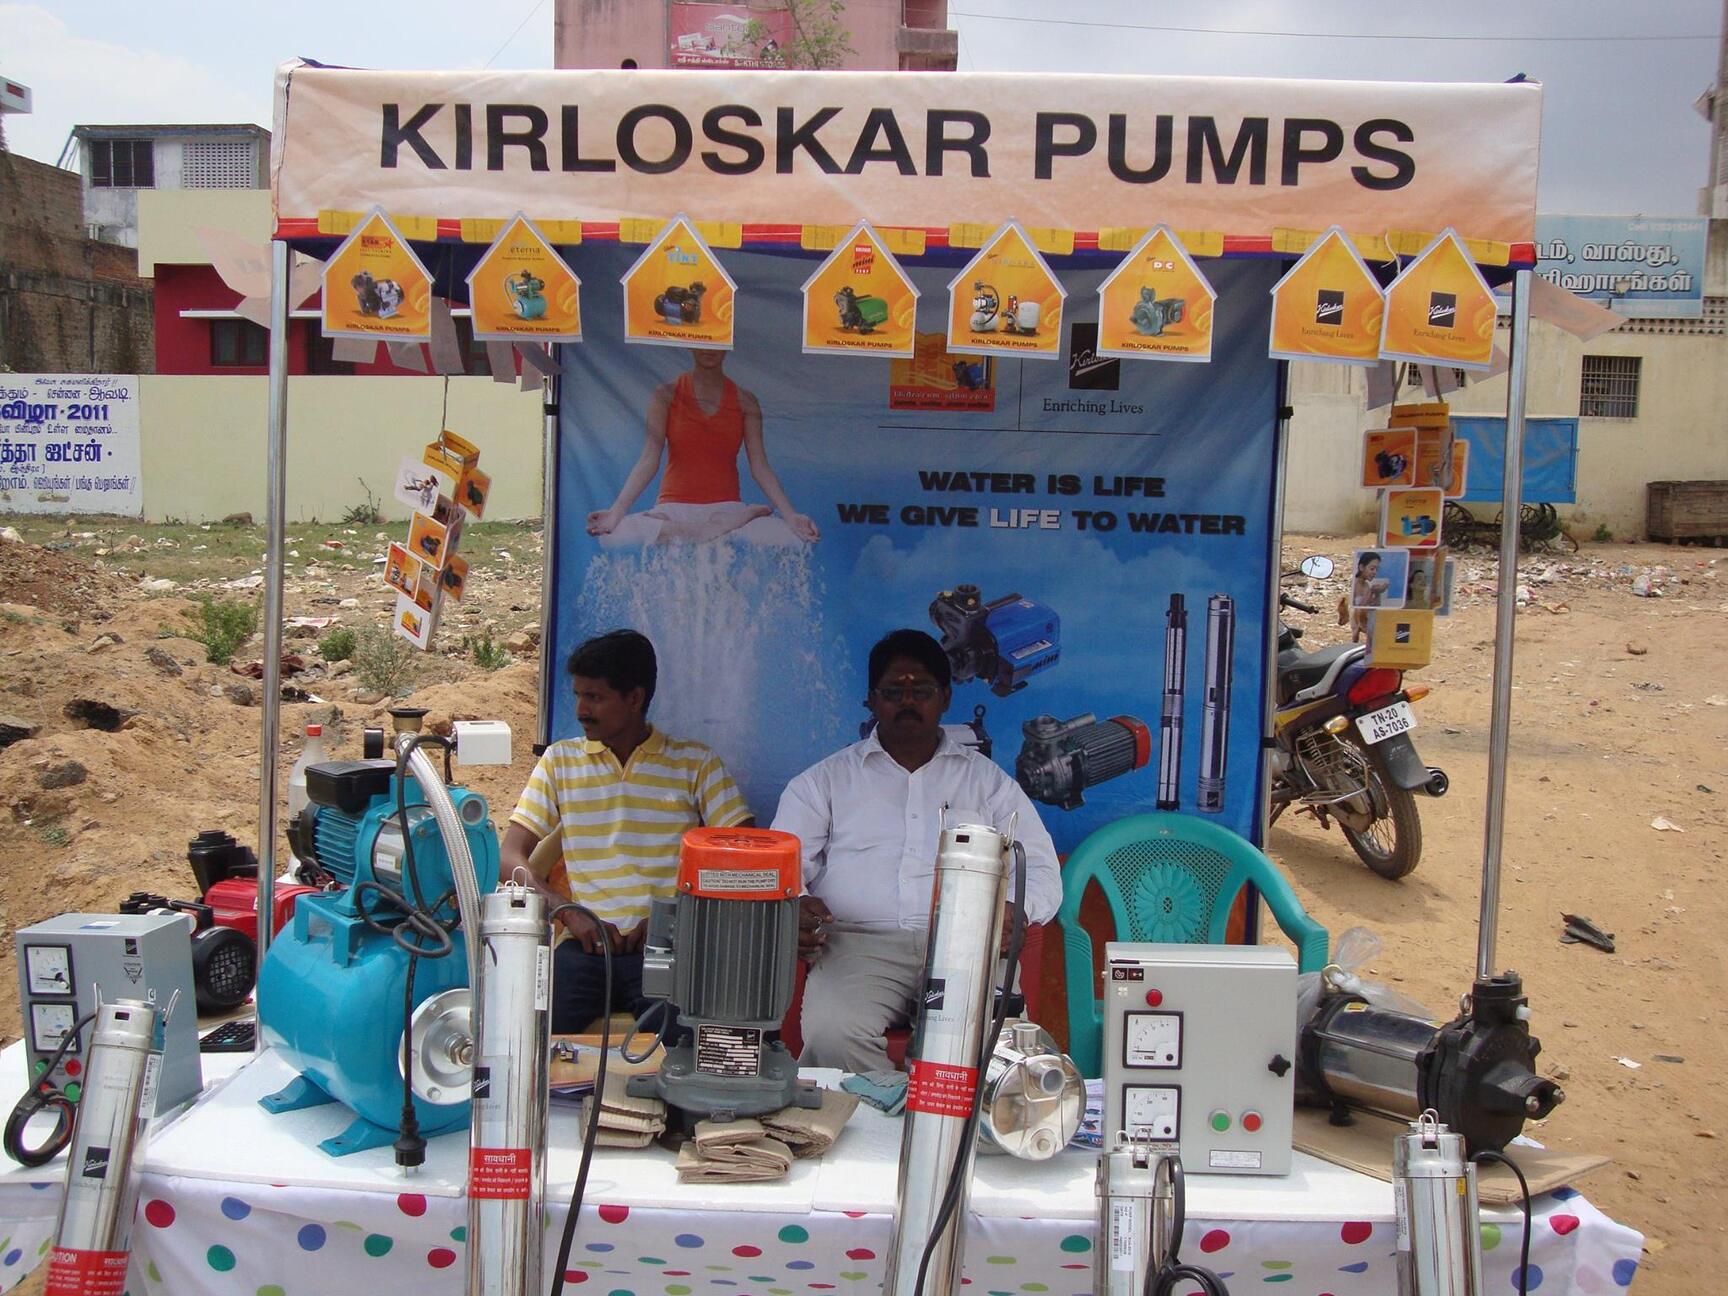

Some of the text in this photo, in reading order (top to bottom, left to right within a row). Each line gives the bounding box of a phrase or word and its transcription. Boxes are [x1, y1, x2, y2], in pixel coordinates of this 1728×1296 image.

[382, 104, 1415, 190] KIRLOSKAR PUMPS
[510, 246, 541, 255] eterna
[345, 323, 383, 331] KIRLOSKAR
[495, 325, 534, 333] KIRLOSKAR
[1301, 327, 1354, 339] Enriching Lives
[648, 330, 713, 341] KIRLOSKAR PUMPS
[1413, 329, 1466, 341] Enriching Lives
[826, 339, 866, 347] KIRLOSKAR
[971, 338, 1038, 348] KIRLOSKAR PUMPS
[1121, 342, 1189, 352] KIRLOSKAR PUMPS
[47, 386, 81, 400] சென்னை
[0, 399, 110, 424] விழா 2011
[1042, 398, 1144, 415] Enriching Lives
[919, 470, 1165, 498] WATER IS LIFE
[838, 503, 1246, 536] WE GIVE LIFE TO WATER
[1370, 707, 1398, 725] TN-20
[1372, 717, 1409, 740] AS-7036
[935, 1070, 968, 1081] सावधानी
[484, 1152, 516, 1164] सावधानी
[48, 1251, 77, 1264] AUTION
